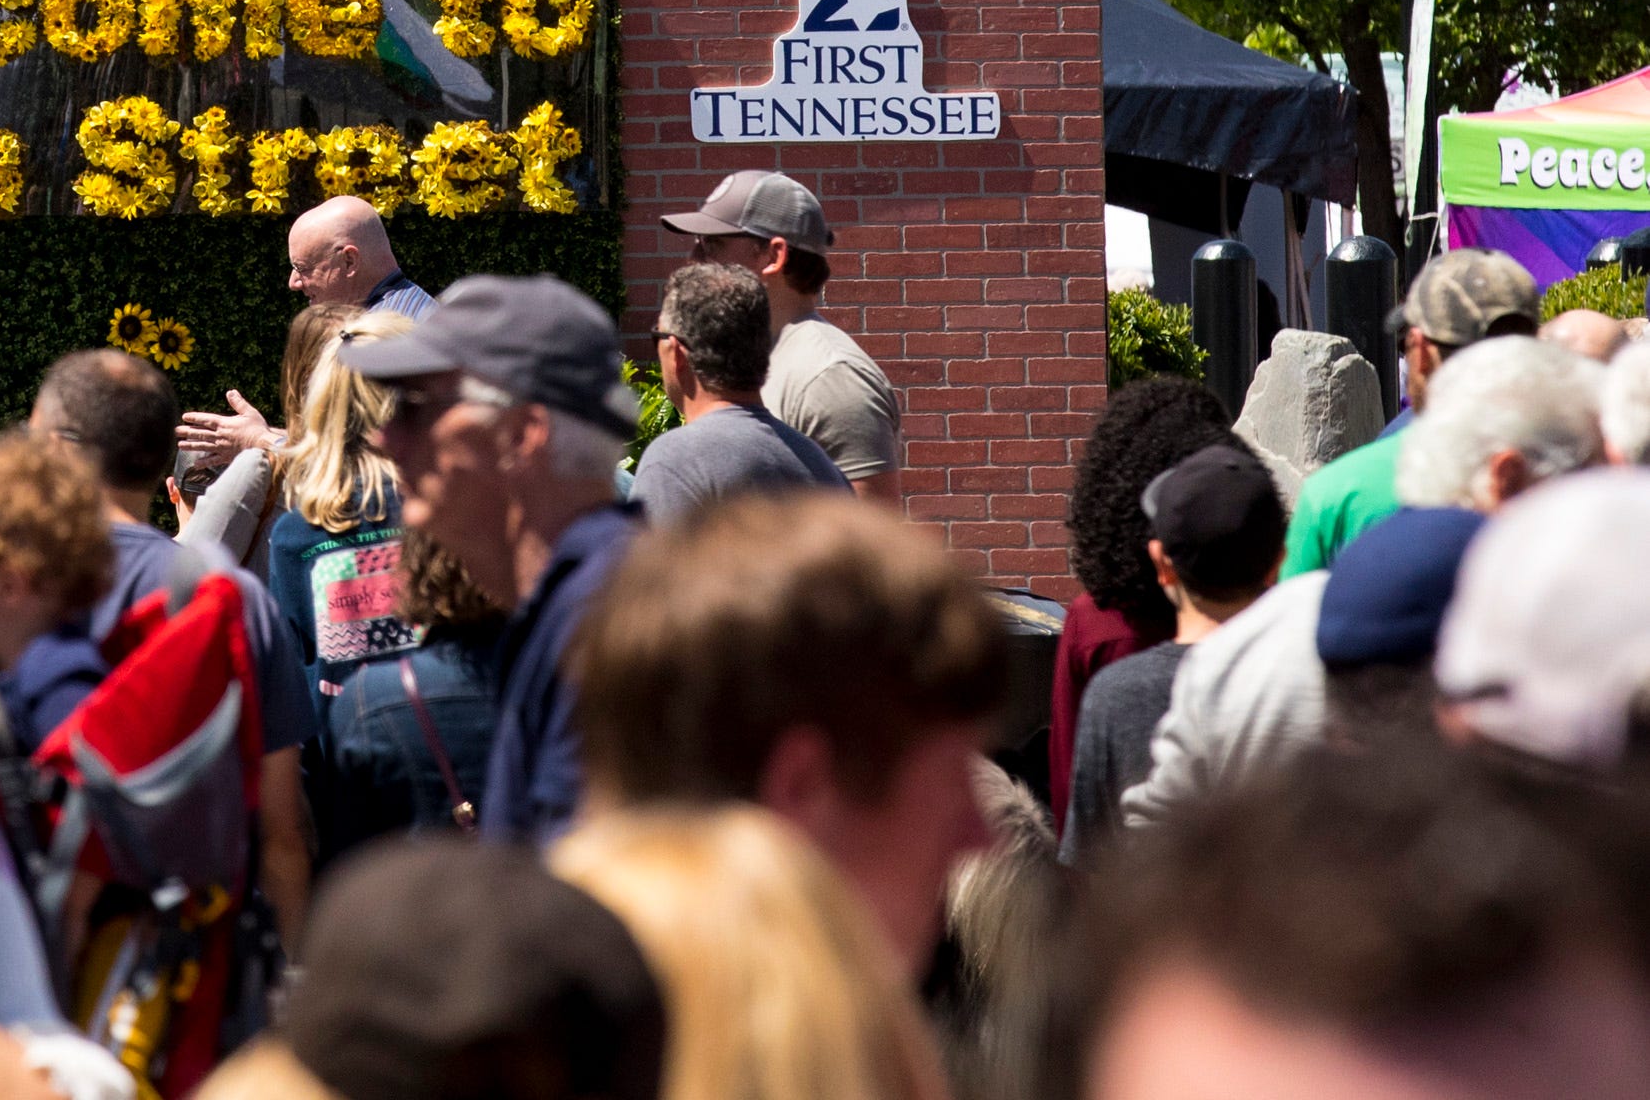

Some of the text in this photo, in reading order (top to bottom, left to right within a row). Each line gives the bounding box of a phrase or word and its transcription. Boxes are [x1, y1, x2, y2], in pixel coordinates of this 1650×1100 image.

[779, 38, 920, 86] FIRST
[693, 90, 997, 139] TENNESSEE
[72, 95, 585, 221] Street
